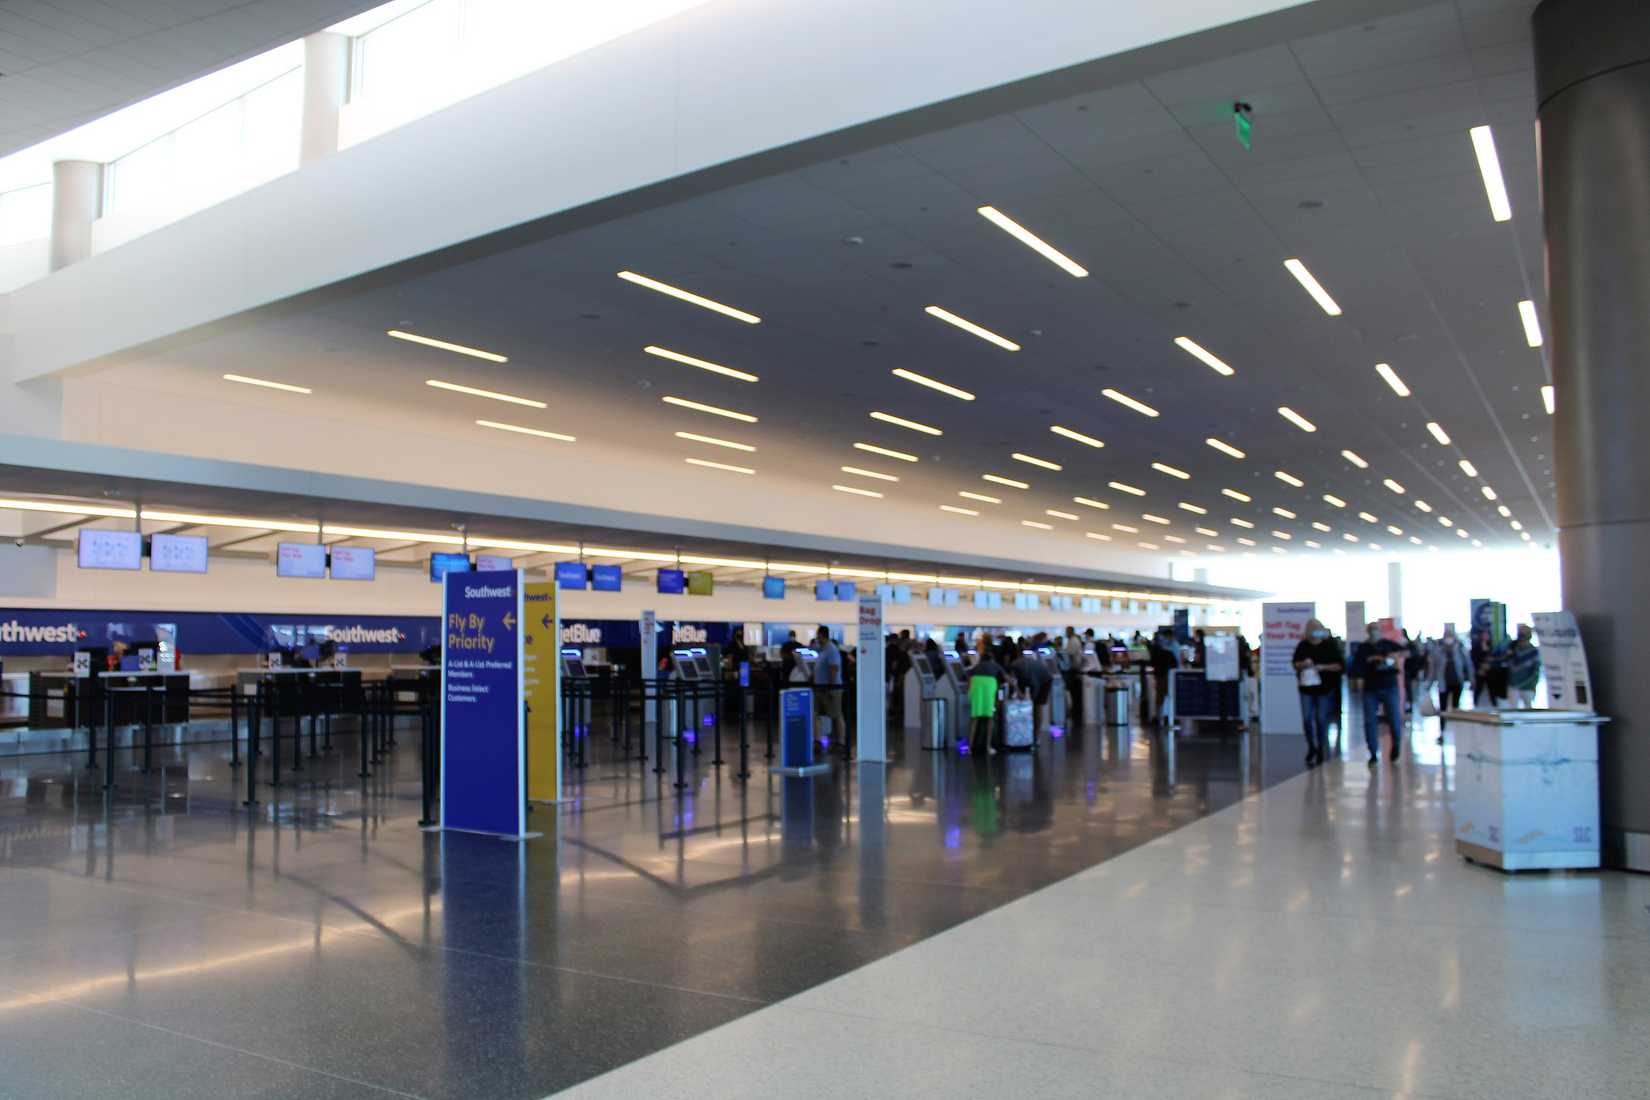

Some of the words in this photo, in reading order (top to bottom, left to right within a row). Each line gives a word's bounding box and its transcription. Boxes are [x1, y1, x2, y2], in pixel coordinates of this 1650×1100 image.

[464, 586, 511, 598] Southwest
[0, 620, 77, 642] thwest
[448, 613, 465, 631] Fly
[468, 613, 485, 631] By
[325, 624, 400, 643] Southwest
[448, 633, 495, 653] Priority
[560, 624, 601, 645] jetBlue
[672, 623, 707, 644] jetBlue
